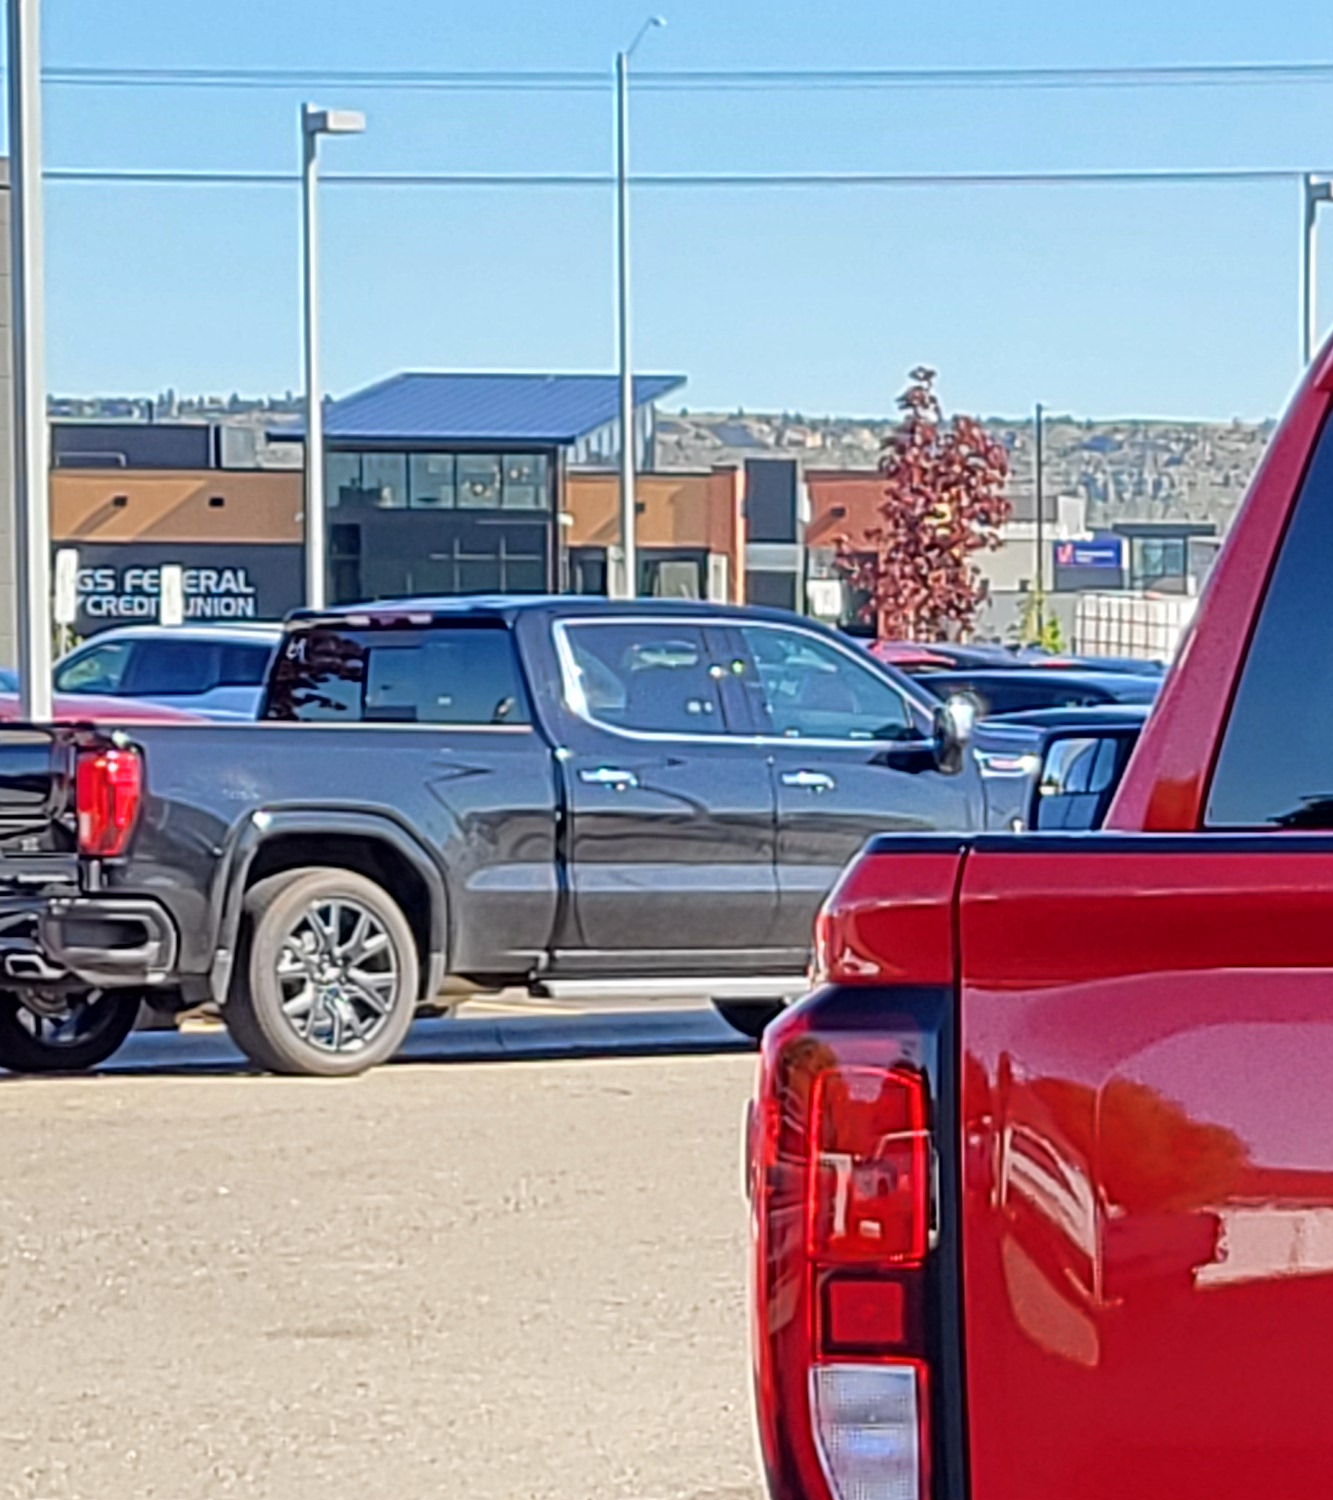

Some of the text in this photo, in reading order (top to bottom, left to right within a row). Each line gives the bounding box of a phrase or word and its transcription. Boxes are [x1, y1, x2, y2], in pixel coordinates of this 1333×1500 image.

[77, 568, 254, 593] GS FEERAL
[85, 595, 157, 617] CREDI
